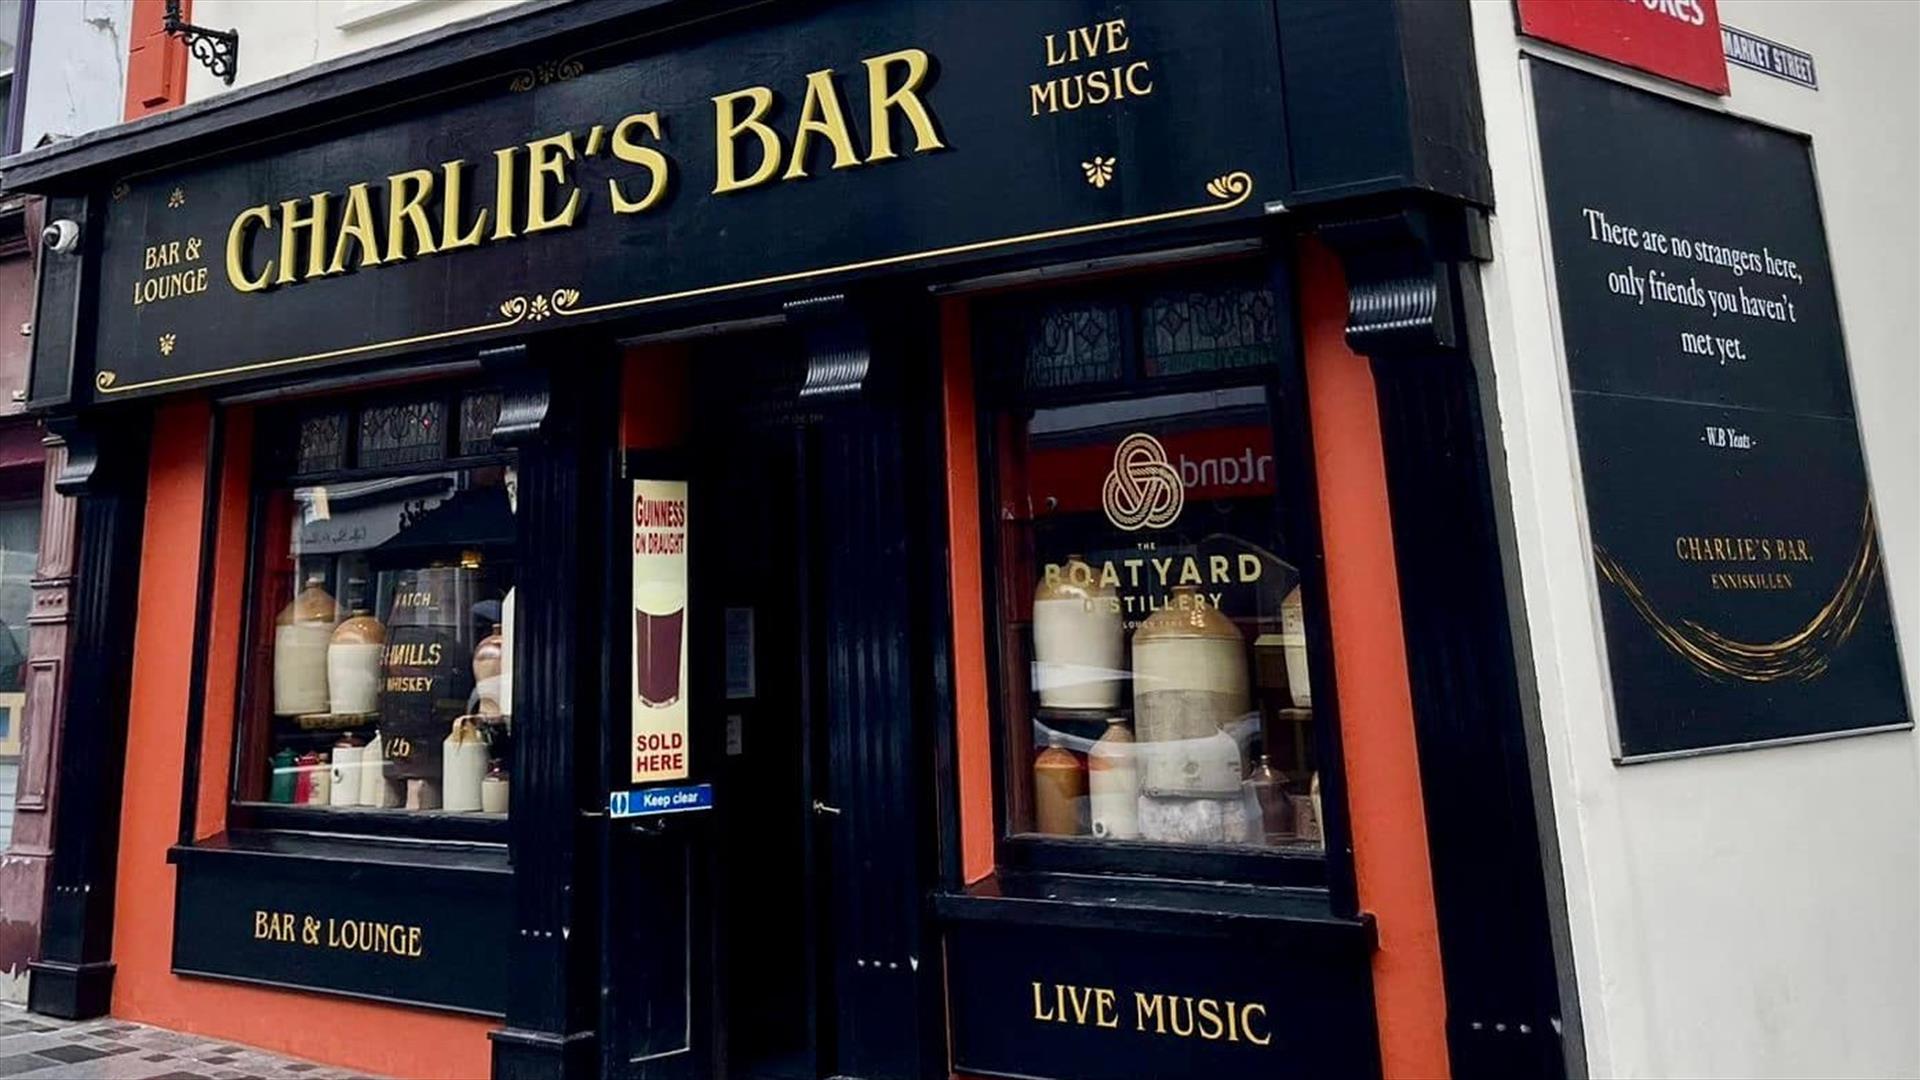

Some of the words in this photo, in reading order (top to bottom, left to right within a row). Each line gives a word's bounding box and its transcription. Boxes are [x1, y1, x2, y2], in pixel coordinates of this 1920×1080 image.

[1044, 18, 1129, 67] LIVE
[1723, 30, 1770, 69] MARKET
[1772, 47, 1814, 83] STREET
[1030, 61, 1153, 117] MUSIC
[226, 110, 669, 293] CHARLIE'S
[710, 47, 944, 195] BAR
[145, 240, 180, 271] BAR
[185, 236, 202, 261] &
[1583, 207, 1639, 249] There
[1642, 229, 1668, 254] are
[1670, 236, 1692, 259] no
[1694, 240, 1763, 277] strangers
[1763, 247, 1803, 285] here,
[133, 266, 209, 305] LOUNGE
[1608, 265, 1645, 305] only
[1648, 268, 1706, 309] friends
[1707, 289, 1739, 318] you
[1739, 286, 1797, 323] haven't
[1681, 331, 1716, 357] met
[1716, 336, 1747, 365] yet.
[1727, 428, 1751, 449] Yeats
[635, 495, 685, 527] GUINNESS
[635, 532, 647, 555] ON
[648, 532, 685, 555] DRAUGHT
[1137, 542, 1156, 551] THE
[1675, 536, 1772, 562] CHARLIE'S
[1044, 553, 1263, 588] BOATYARD
[1711, 573, 1793, 589] ENNISKILLEN
[1083, 592, 1223, 614] DSTILLERY
[636, 732, 683, 752] SOLD
[636, 753, 683, 773] HERE
[643, 793, 671, 809] Keep
[672, 790, 699, 805] clear
[255, 910, 296, 942] BAR
[302, 915, 321, 946] &
[328, 918, 423, 957] LOUNGE
[1032, 981, 1119, 1029] LIVE
[1134, 991, 1272, 1046] MUSIC
